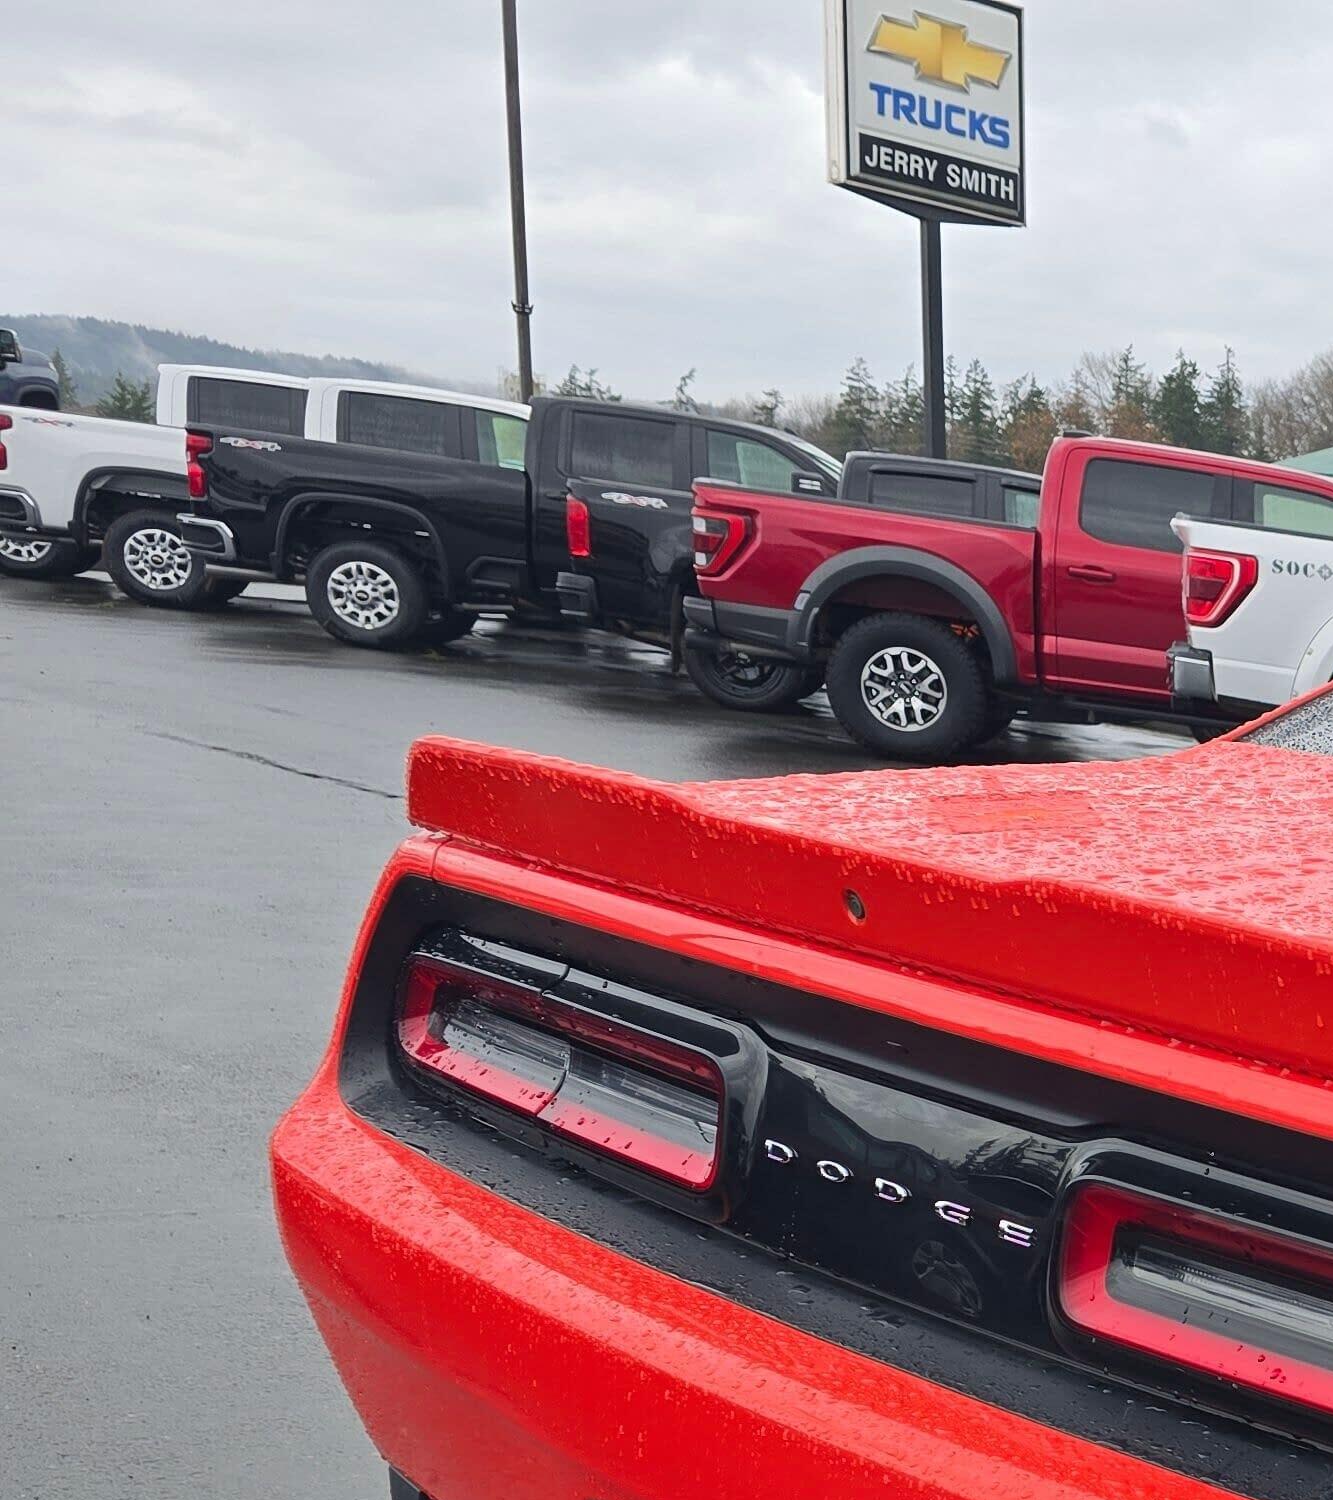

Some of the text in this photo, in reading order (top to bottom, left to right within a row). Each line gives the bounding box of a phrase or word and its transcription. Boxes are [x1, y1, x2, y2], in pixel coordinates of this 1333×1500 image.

[869, 81, 1010, 149] TRUCKS
[865, 144, 1014, 202] JERRY SMITH
[764, 1138, 1037, 1248] DODGE
